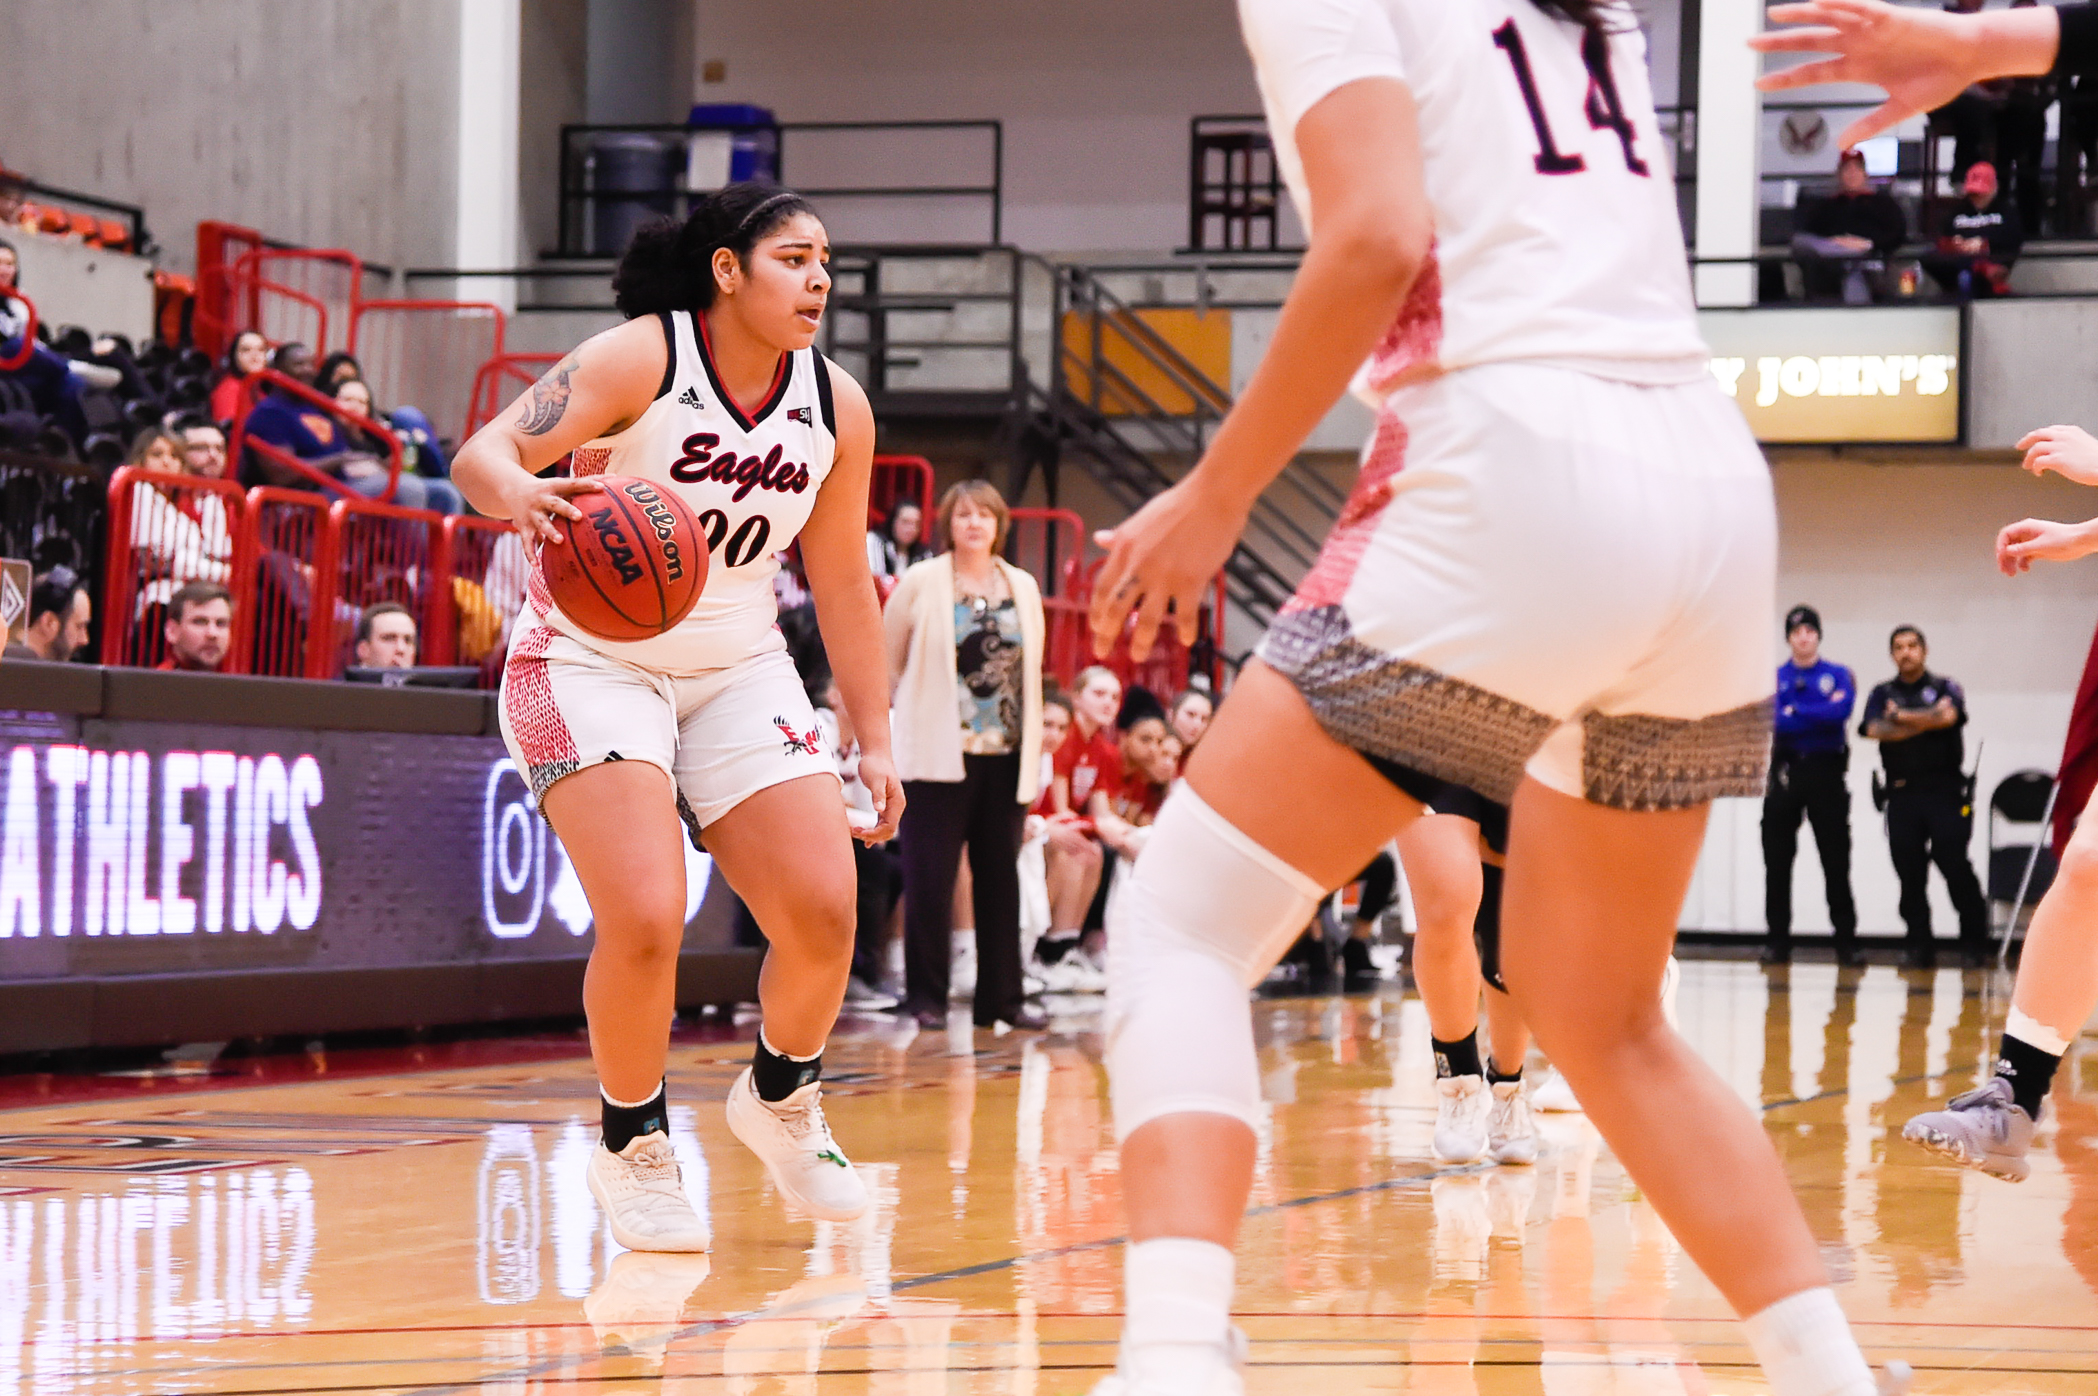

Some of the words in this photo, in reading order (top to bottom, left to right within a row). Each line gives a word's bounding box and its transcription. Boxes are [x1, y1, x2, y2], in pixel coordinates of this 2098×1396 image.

[1491, 15, 1651, 178] 14
[1755, 354, 1950, 407] JOHN'S
[670, 432, 809, 503] Eagles
[588, 507, 645, 586] NCAA
[623, 481, 684, 586] Wilson
[0, 745, 323, 937] ATHLETICS
